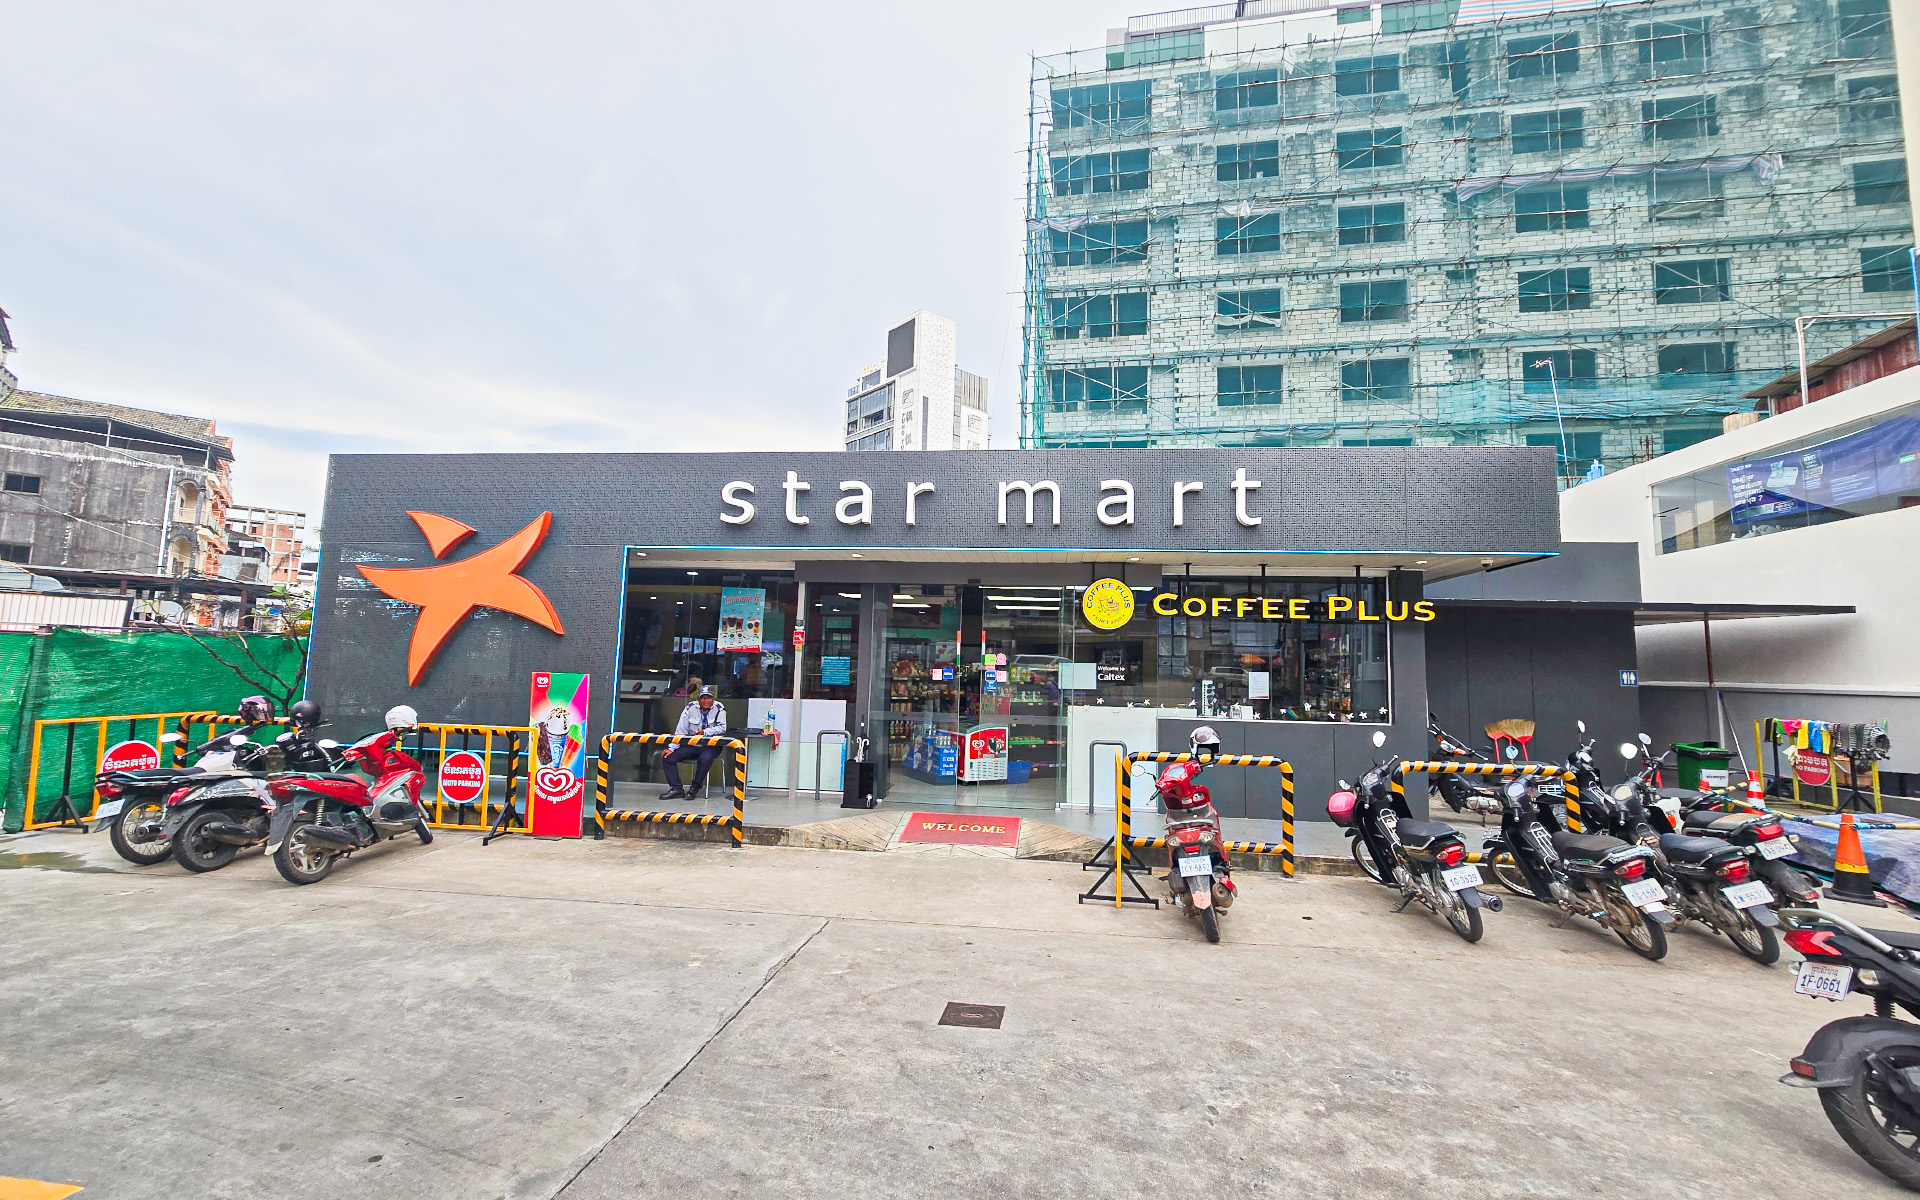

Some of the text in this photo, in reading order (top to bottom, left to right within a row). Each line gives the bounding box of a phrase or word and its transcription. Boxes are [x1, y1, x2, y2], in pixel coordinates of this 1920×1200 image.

[719, 468, 1263, 527] star mart
[1087, 582, 1131, 609] COFFEE PLUS
[1152, 592, 1436, 622] COFFEE PLUS
[1097, 672, 1126, 681] Caltex
[1803, 765, 1829, 775] PARKING
[442, 779, 481, 788] MOTO PARKING
[922, 822, 1006, 834] WELCOME
[1800, 973, 1841, 994] 1F-0661
